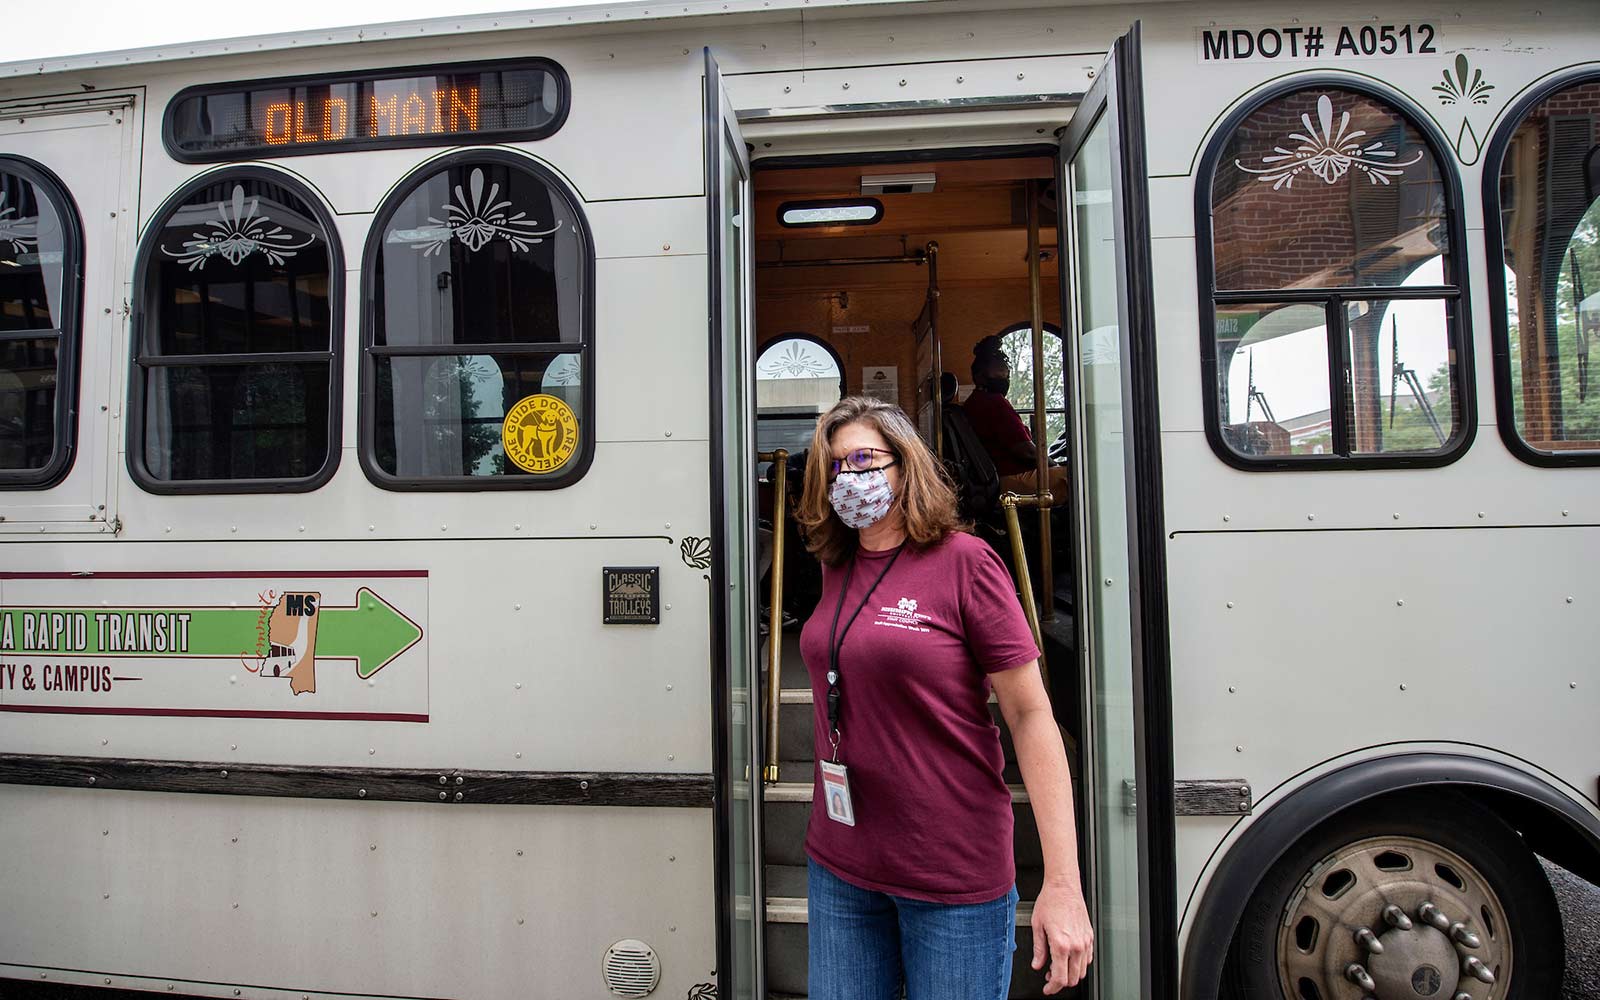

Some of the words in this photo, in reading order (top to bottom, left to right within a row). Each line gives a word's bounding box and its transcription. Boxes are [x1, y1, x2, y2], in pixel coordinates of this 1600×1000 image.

[1202, 27, 1324, 60] MDOT#
[1334, 24, 1437, 56] A0512
[265, 97, 347, 146] OLD
[369, 87, 478, 138] MAIN
[507, 400, 536, 433] GUIDE
[540, 399, 571, 423] DOGS
[508, 439, 563, 469] WELCOME
[562, 428, 574, 453] ARE
[608, 573, 651, 592] CLASSIC
[286, 594, 316, 616] MS
[608, 600, 651, 615] TROLLEYS
[0, 612, 16, 650] A
[23, 612, 87, 652] RAPID
[95, 613, 191, 653] TRANSIT
[240, 587, 277, 674] Commute
[22, 664, 36, 691] &
[43, 664, 112, 692] CAMPUS
